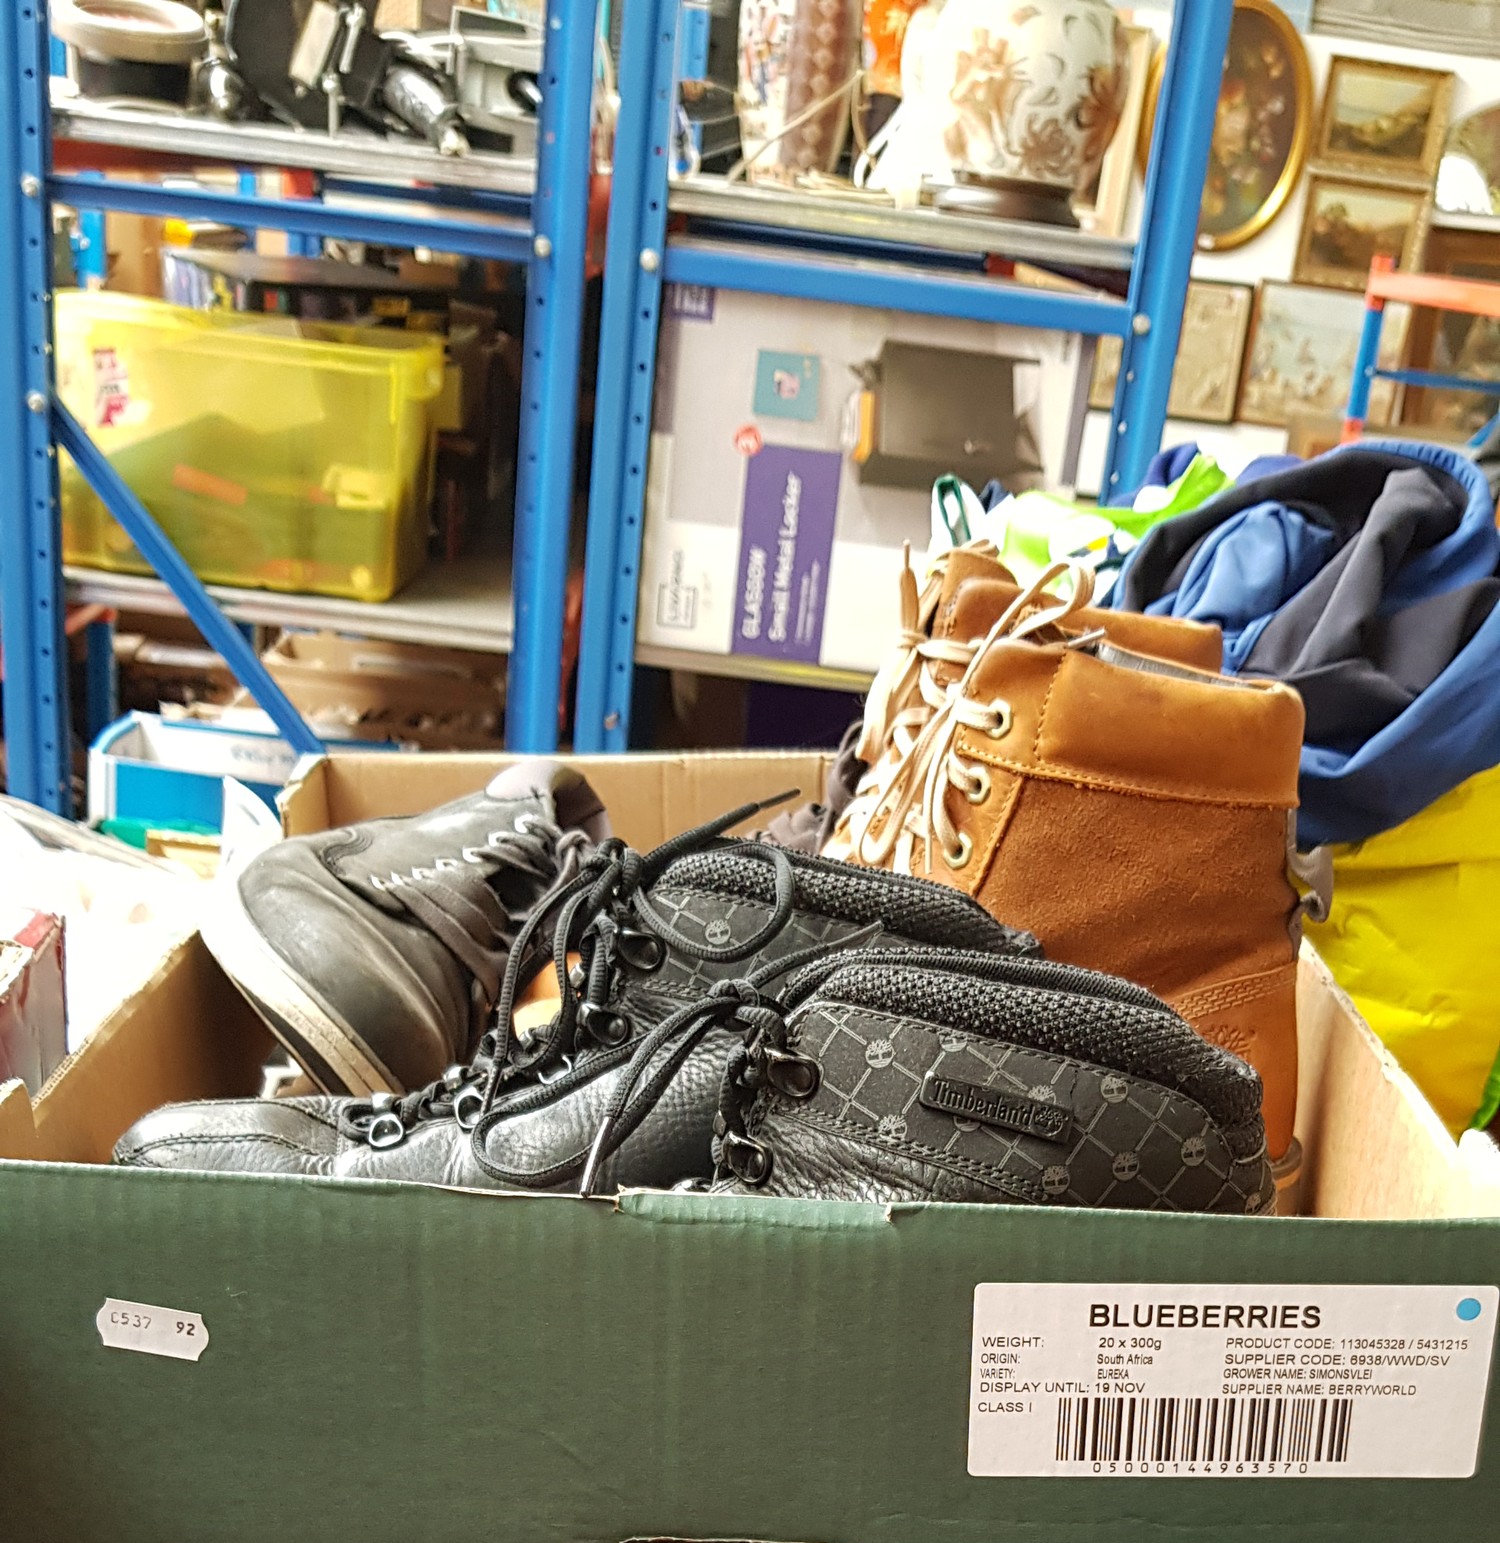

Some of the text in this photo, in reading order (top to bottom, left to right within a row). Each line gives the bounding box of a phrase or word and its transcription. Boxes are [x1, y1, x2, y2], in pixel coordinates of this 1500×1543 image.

[932, 1080, 1036, 1128] Timberland
[1089, 1304, 1321, 1329] BLUEBERRIES
[176, 1321, 196, 1336] 92
[982, 1336, 1162, 1351] WEIGHT: 20 x 300g
[1226, 1338, 1291, 1349] PRODUCT
[1294, 1338, 1336, 1349] CODE:
[1341, 1339, 1405, 1350] 113045328
[1416, 1339, 1469, 1350] 5431215
[981, 1353, 1153, 1365] ORIGIN: South Africa
[1224, 1354, 1451, 1366] SUPPLIER CODE: 6938/WWD/SV
[980, 1368, 1129, 1380] VARIETY: EUREKA
[1223, 1368, 1373, 1380] GROWER NAME: SIMONSVLEI
[980, 1382, 1146, 1393] DISPLAY UNTIL: 19 NOV
[1222, 1384, 1417, 1396] SUPPLIER NAME: BERRYWORLD
[978, 1402, 1024, 1413] CLASS
